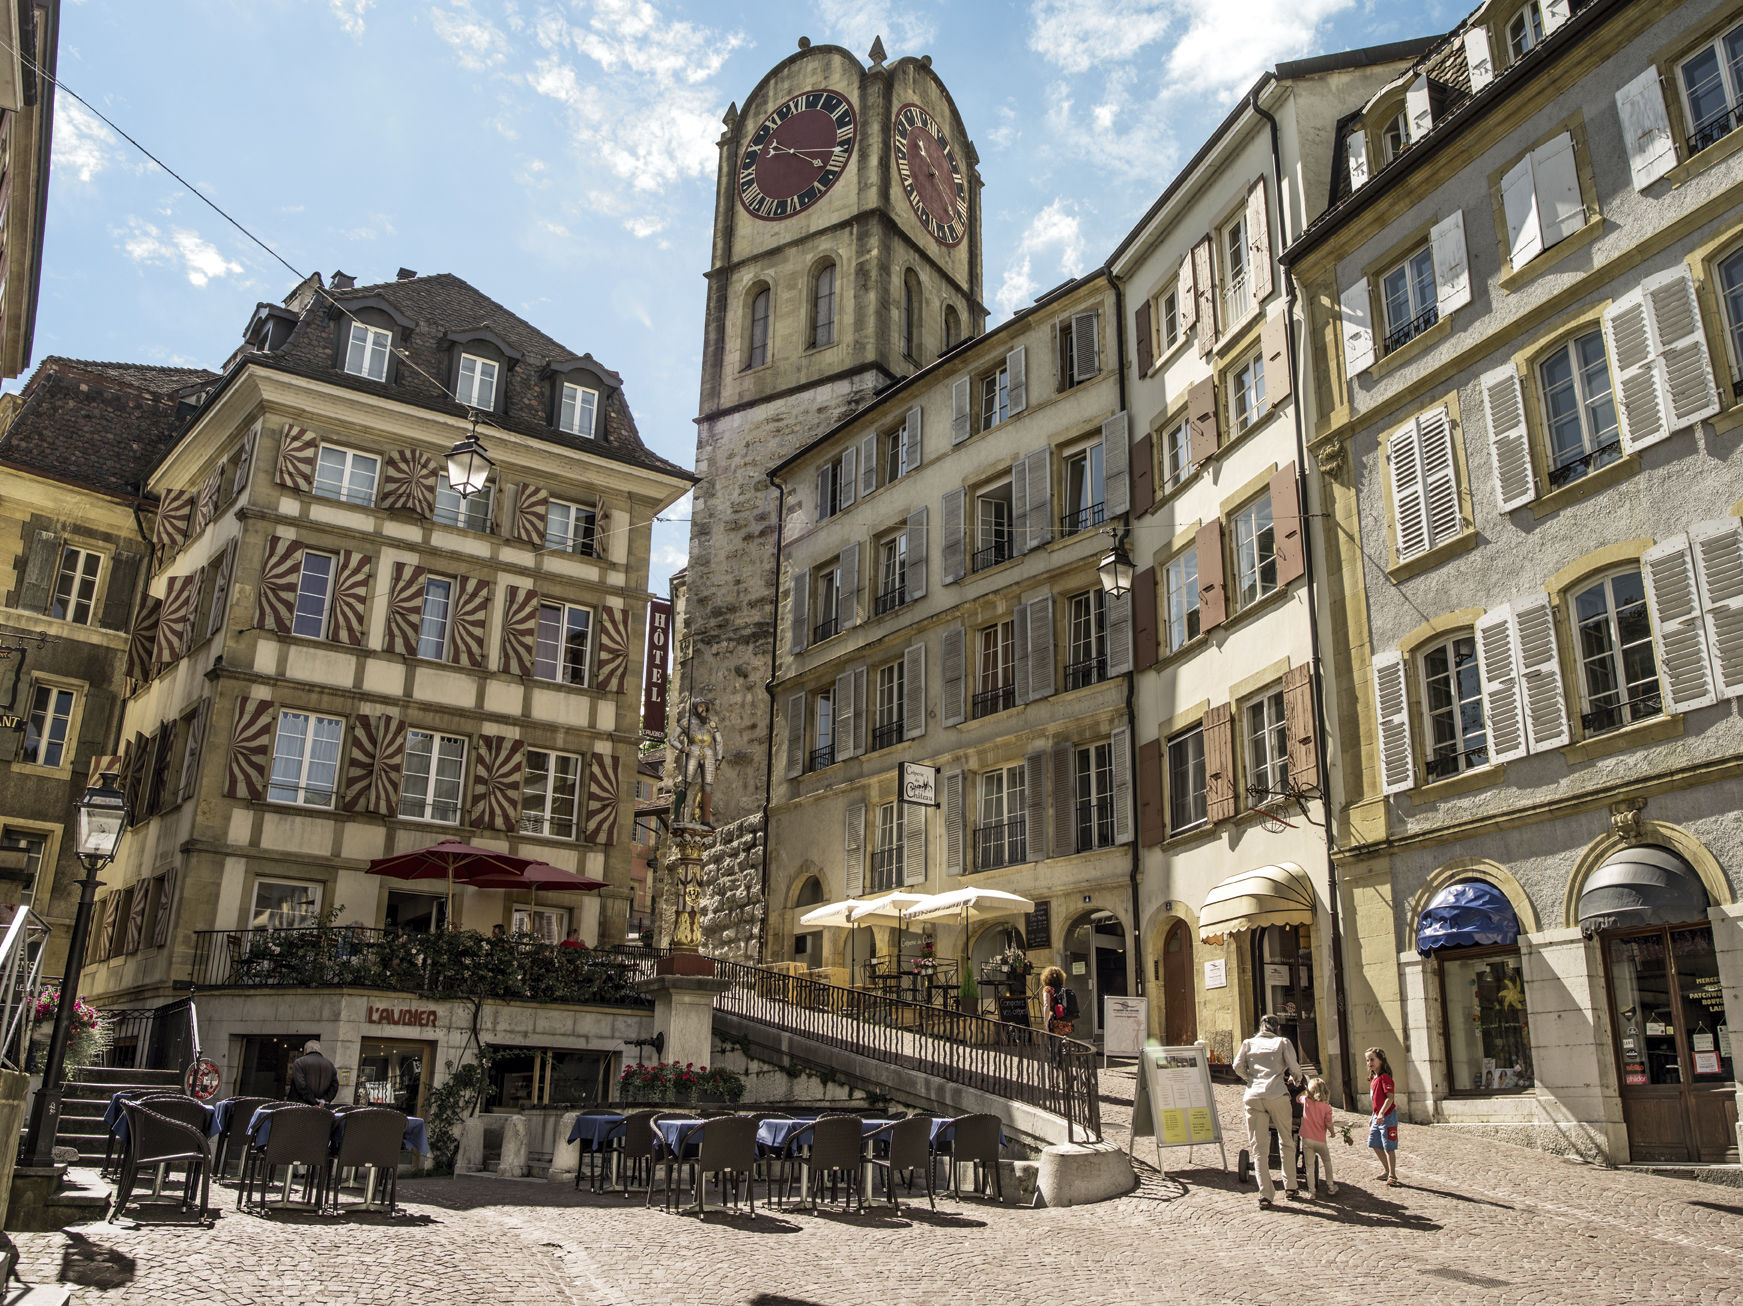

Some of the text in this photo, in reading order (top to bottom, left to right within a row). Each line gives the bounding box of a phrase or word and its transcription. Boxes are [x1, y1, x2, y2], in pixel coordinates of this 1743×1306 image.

[788, 95, 806, 118] XII
[651, 612, 666, 702] HÔTEL
[0, 715, 20, 728] NT
[368, 1005, 437, 1028] L'AUBIER
